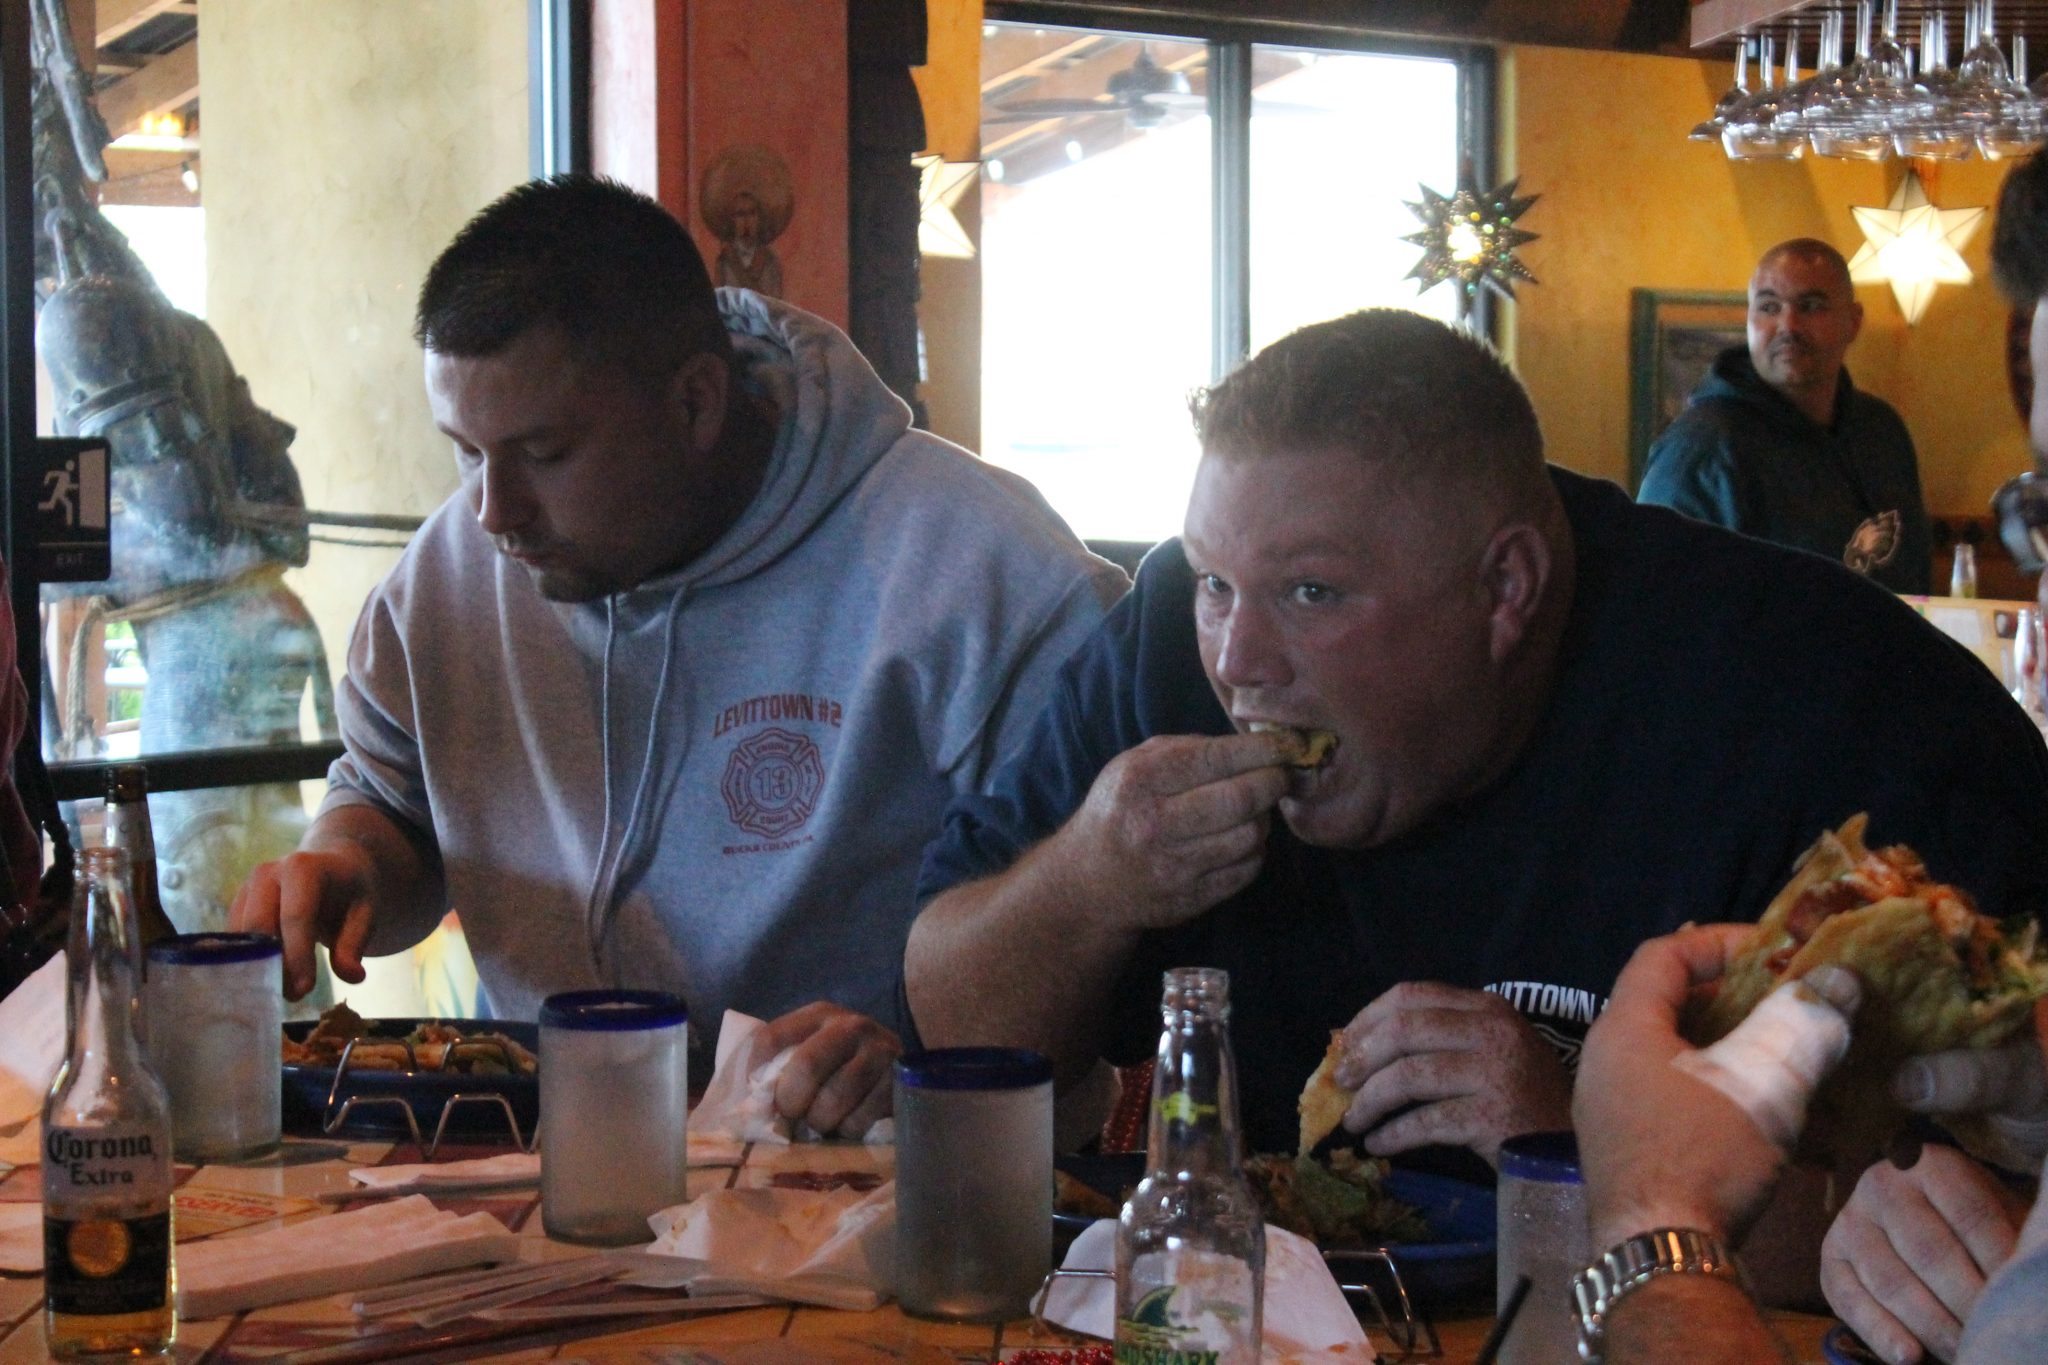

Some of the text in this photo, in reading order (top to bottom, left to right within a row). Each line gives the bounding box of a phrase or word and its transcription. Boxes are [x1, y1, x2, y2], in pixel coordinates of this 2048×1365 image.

[56, 552, 84, 566] EXIT
[713, 693, 814, 738] LEVITTOWN
[47, 1130, 157, 1166] Corona
[70, 1163, 134, 1186] Extra
